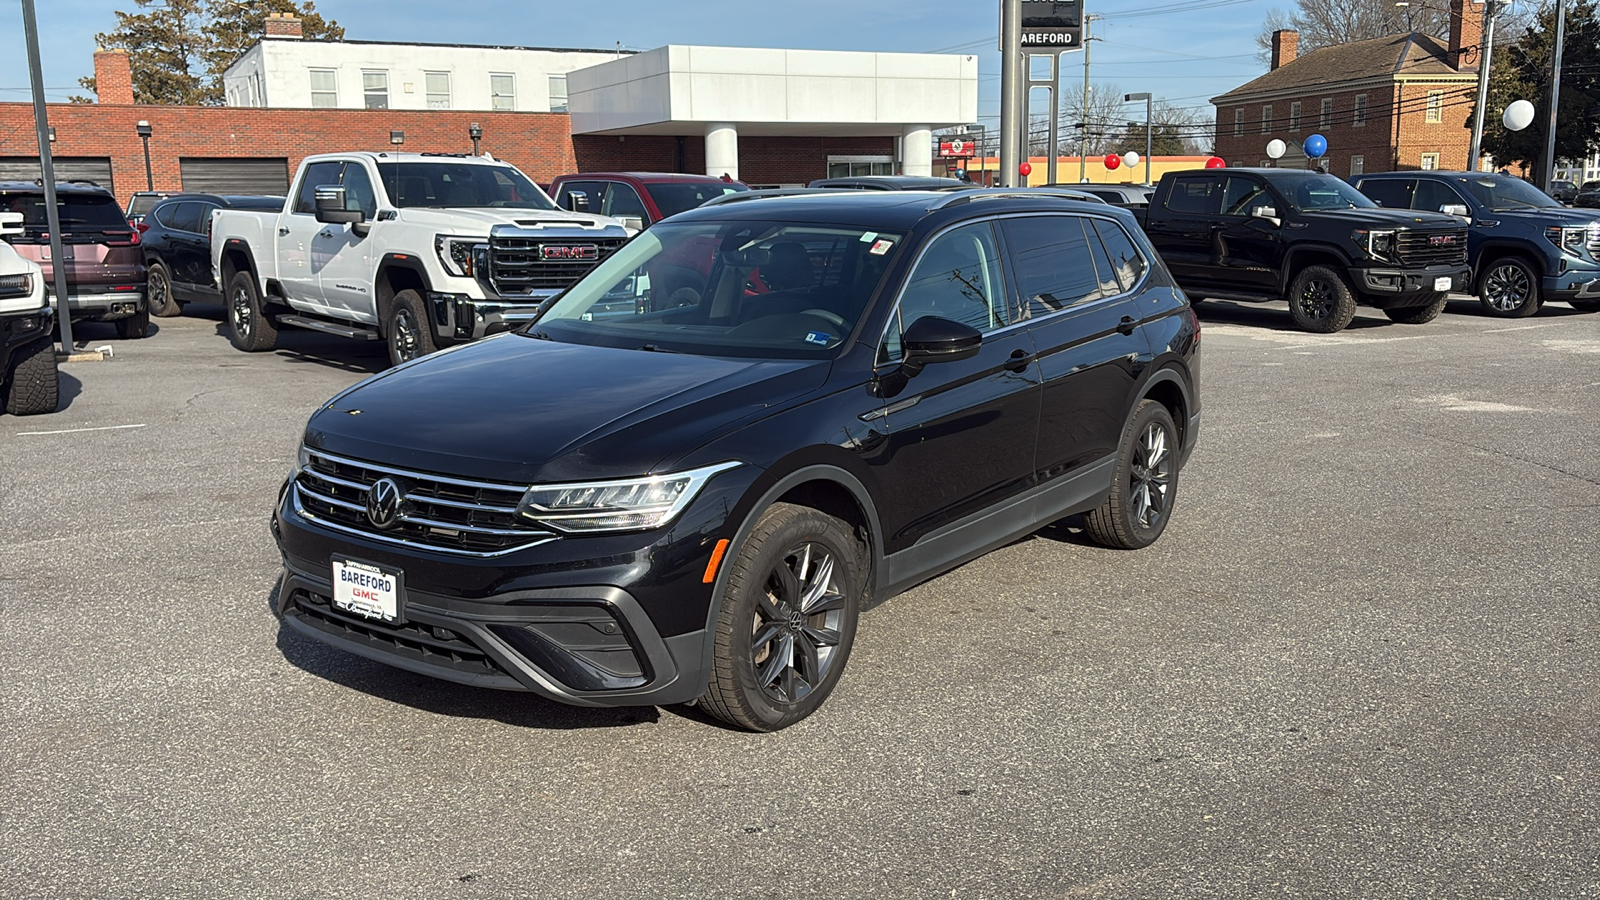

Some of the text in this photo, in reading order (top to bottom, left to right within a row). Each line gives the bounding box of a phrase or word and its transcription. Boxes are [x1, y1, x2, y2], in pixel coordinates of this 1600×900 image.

[1020, 33, 1072, 43] AREFORD
[543, 246, 597, 258] GMC
[341, 569, 391, 593] BAREFORD
[352, 587, 379, 602] GMC
